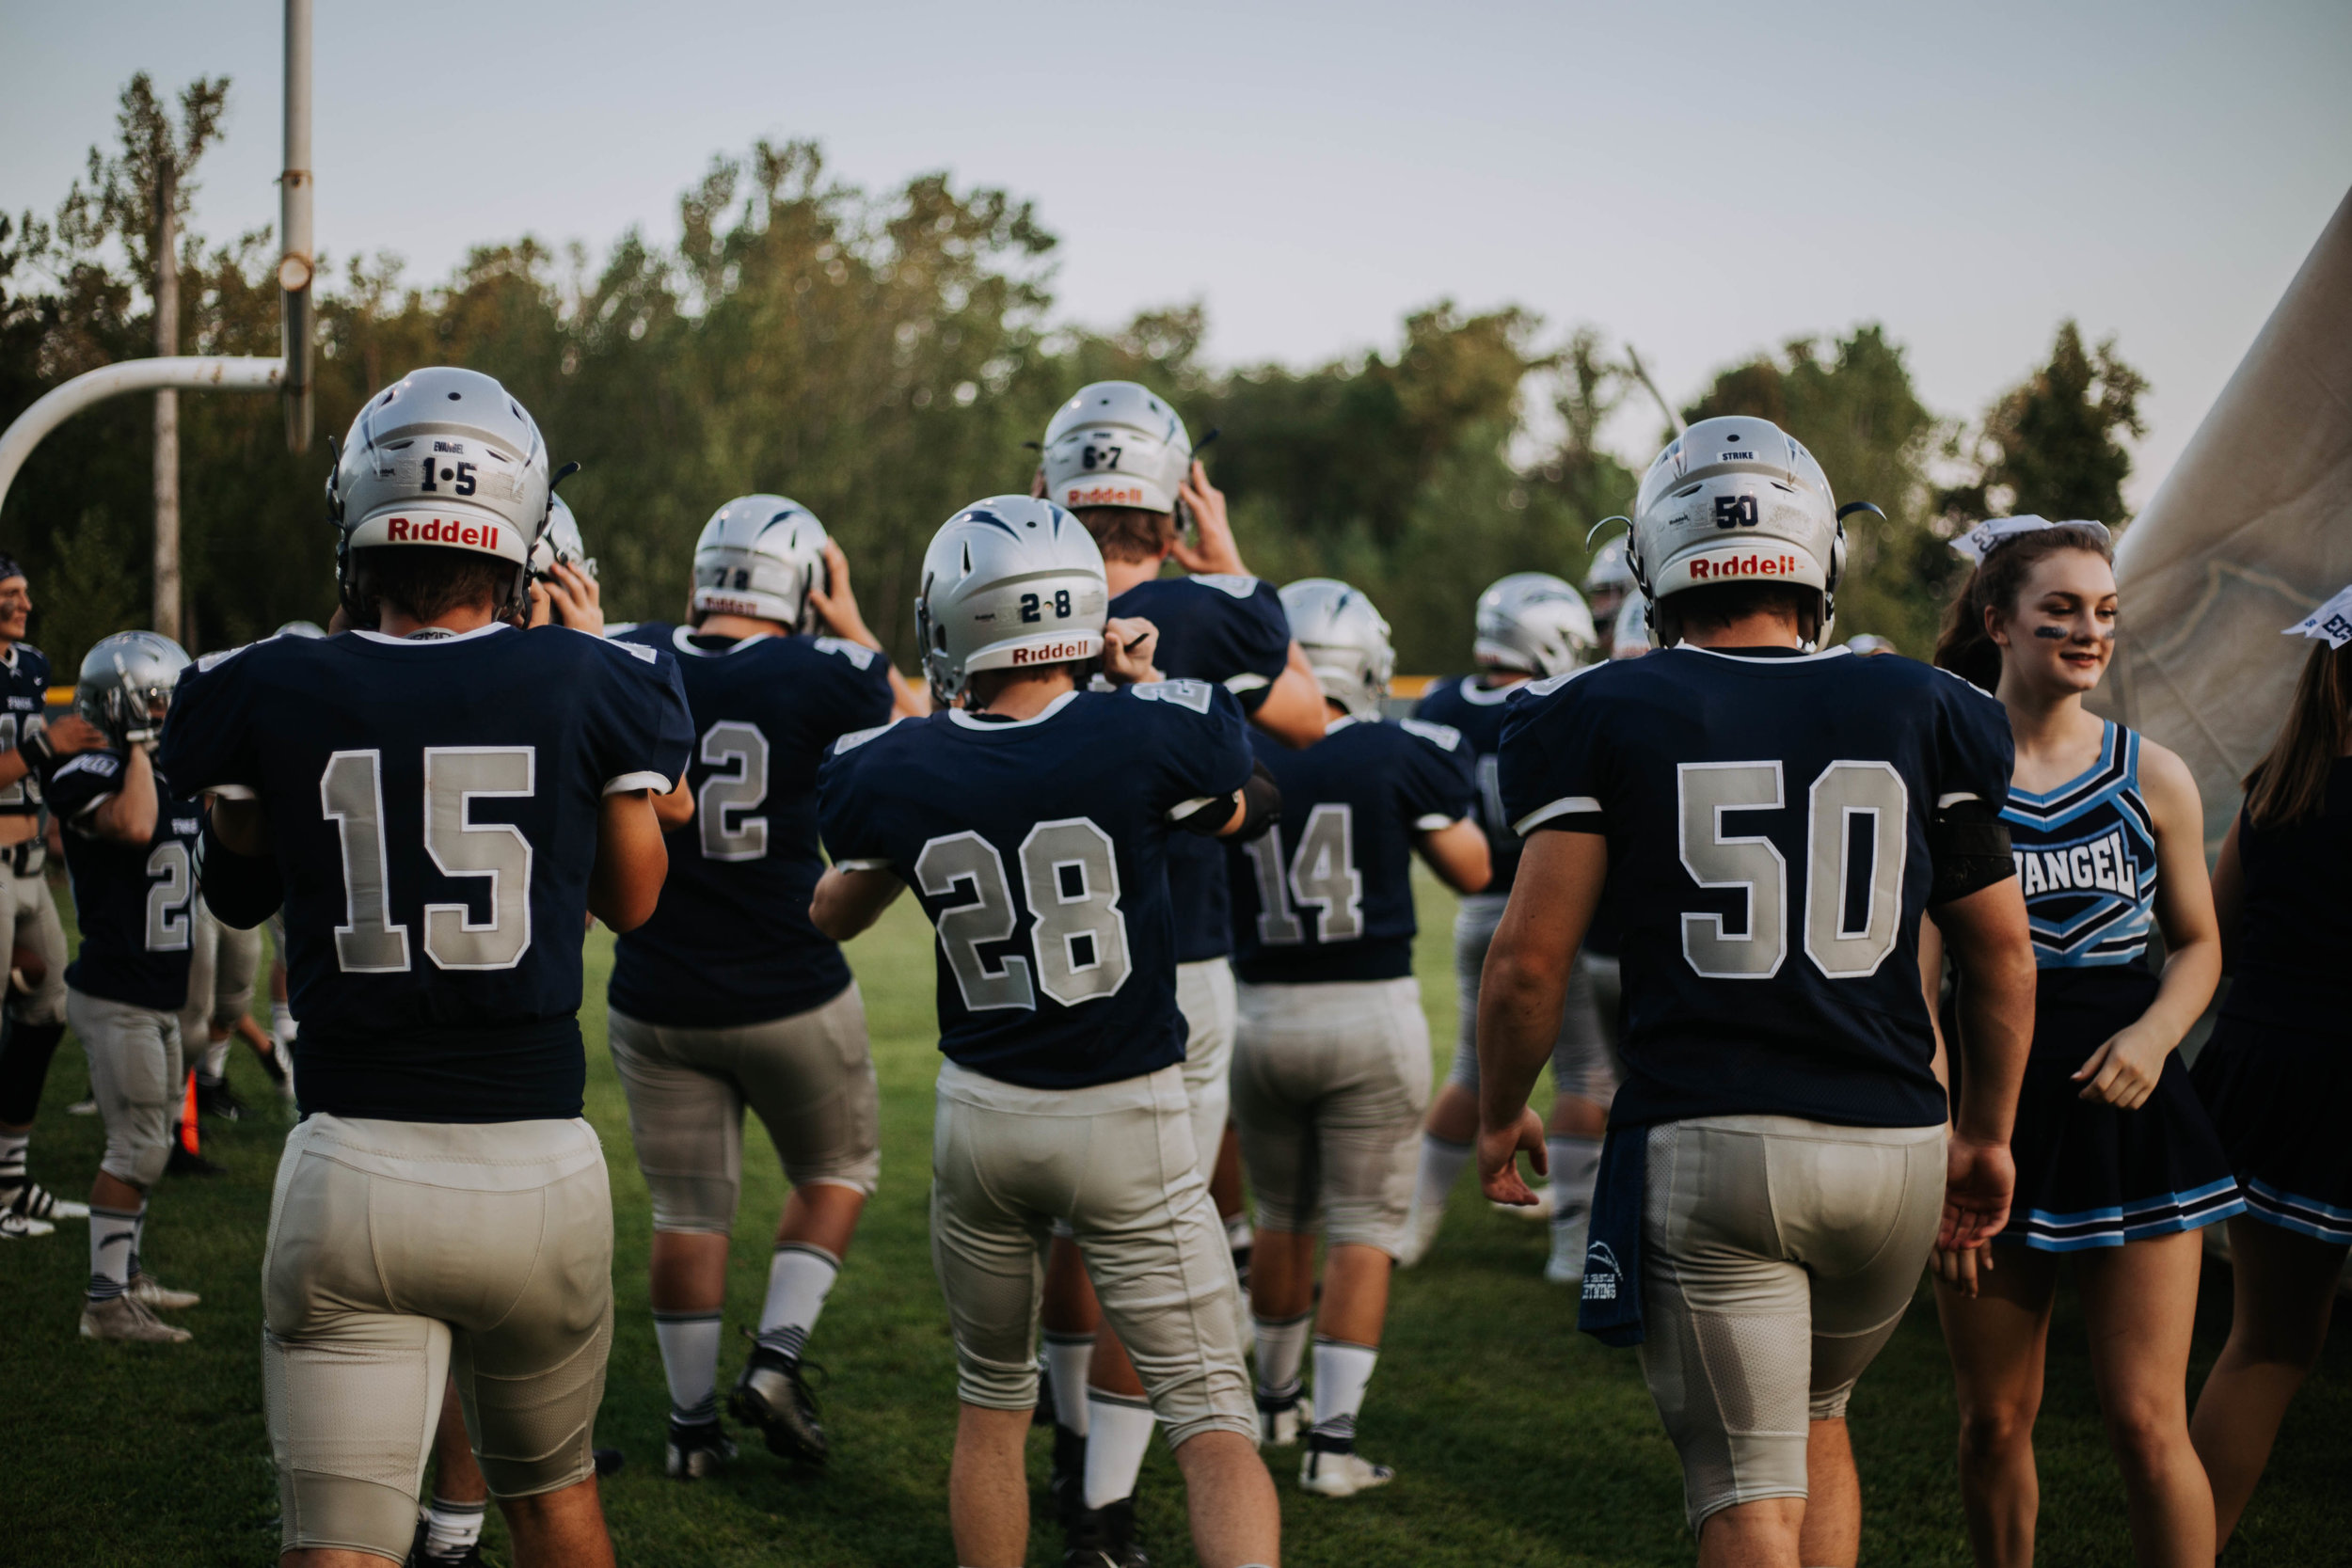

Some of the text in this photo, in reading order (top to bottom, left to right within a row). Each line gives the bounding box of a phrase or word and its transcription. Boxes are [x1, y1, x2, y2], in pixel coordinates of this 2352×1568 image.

[1083, 446, 1122, 469] 67
[1722, 451, 1754, 461] STRIKE
[1068, 486, 1142, 506] Riddell
[1714, 495, 1758, 530] 50
[388, 517, 498, 549] Riddell
[1690, 554, 1794, 579] Riddell
[1020, 590, 1072, 623] 28
[2322, 613, 2352, 640] EC
[1012, 640, 1089, 664] Riddell
[698, 719, 770, 863] 2
[320, 746, 535, 973] 15
[1242, 801, 1364, 946] 14
[1677, 760, 1908, 979] 50
[914, 816, 1133, 1012] 28
